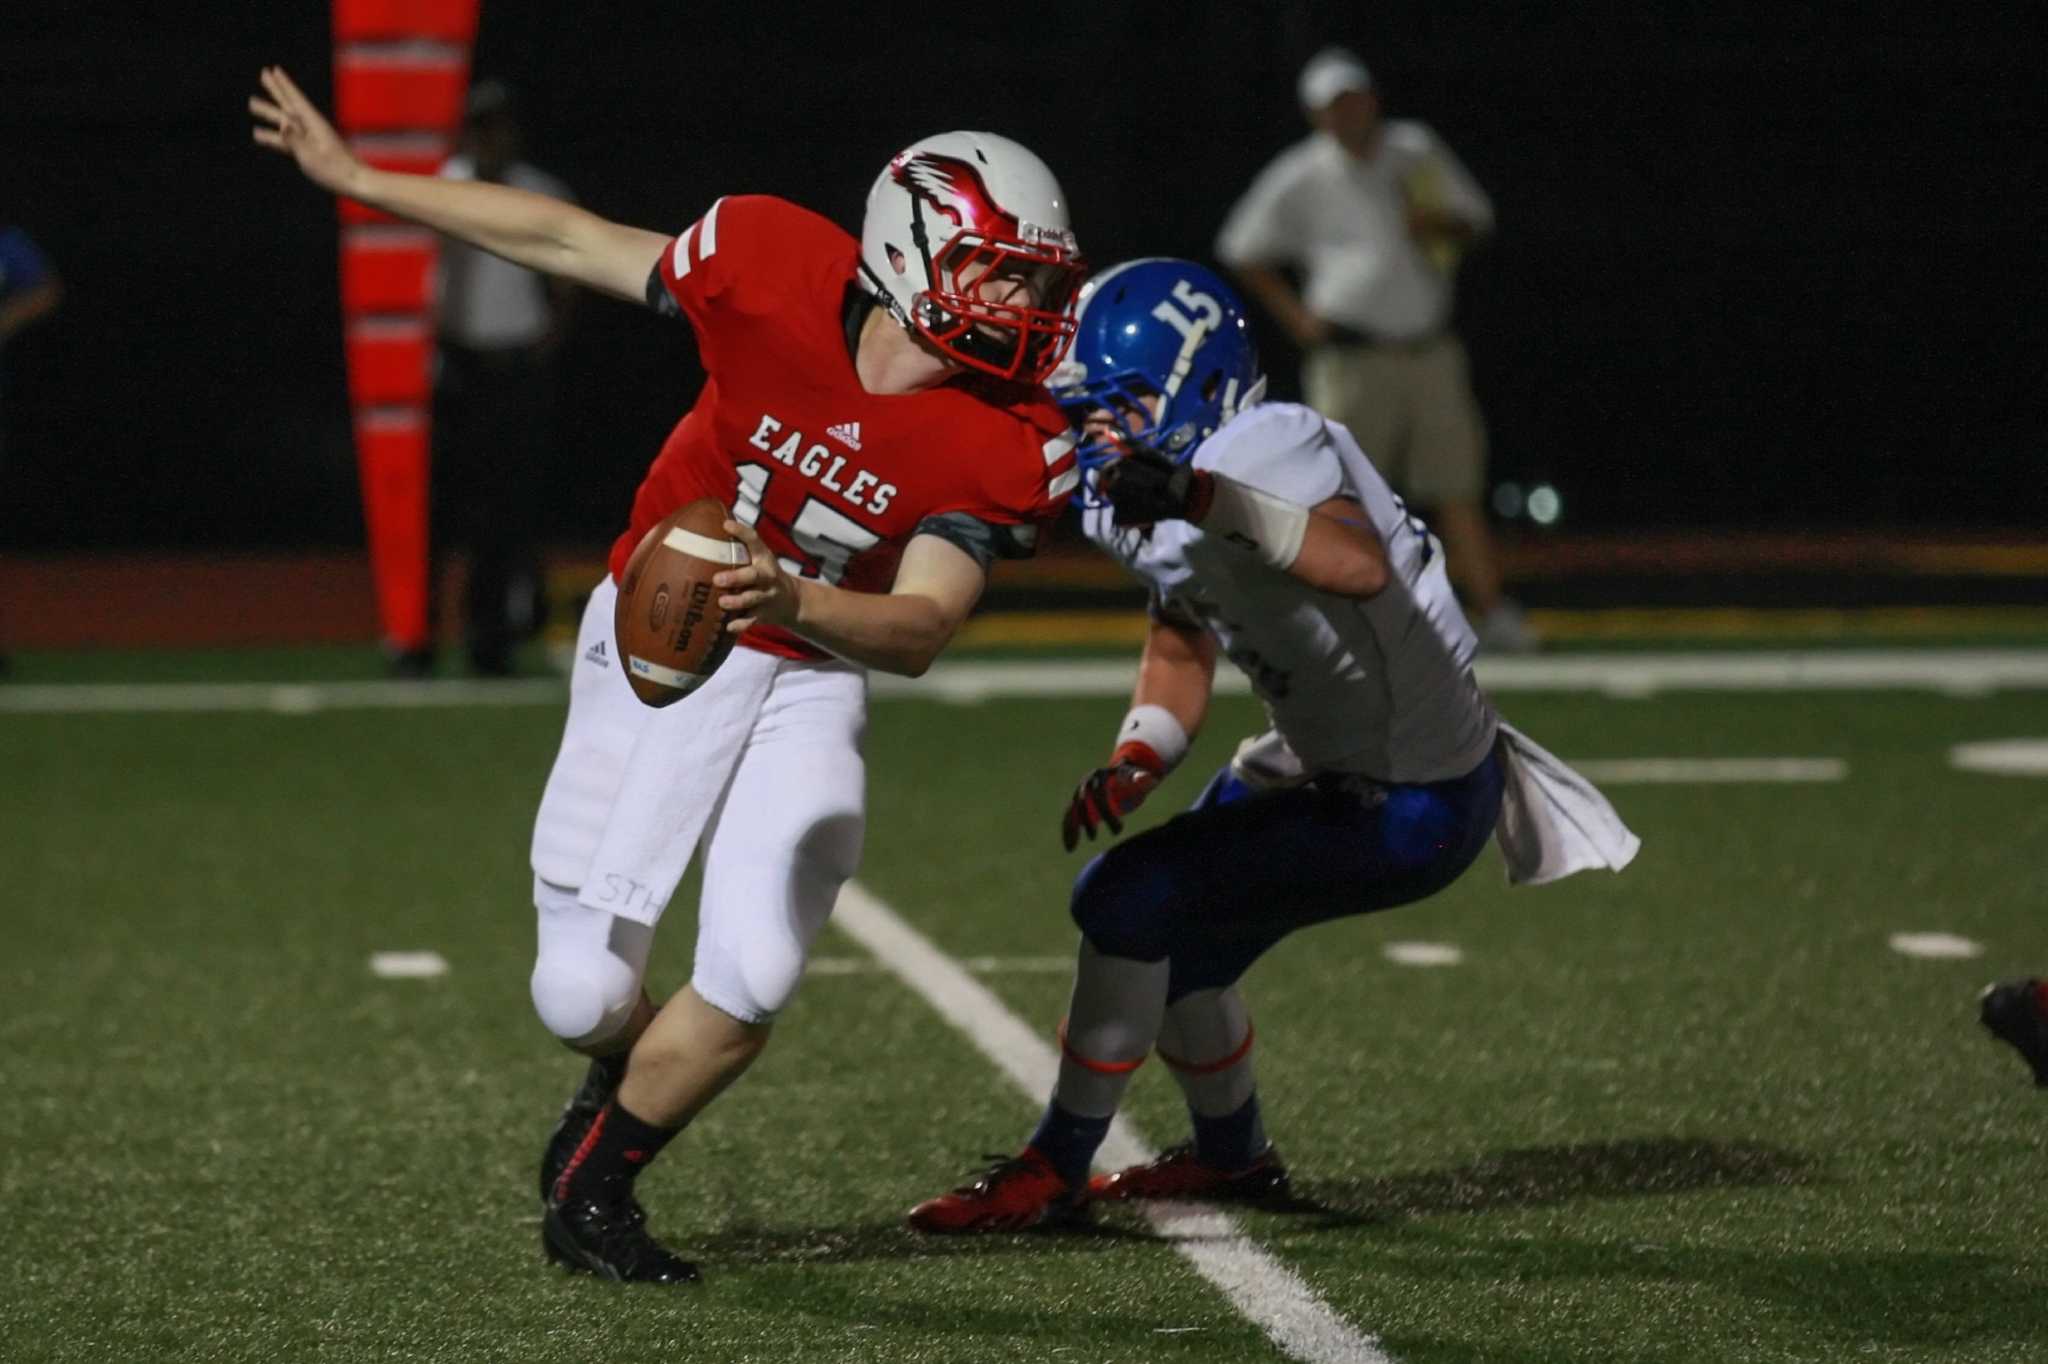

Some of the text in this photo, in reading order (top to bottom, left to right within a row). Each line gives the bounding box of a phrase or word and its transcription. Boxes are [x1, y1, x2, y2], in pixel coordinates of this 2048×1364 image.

[1152, 279, 1222, 342] 15
[749, 415, 897, 515] EAGLES
[732, 463, 880, 587] 15
